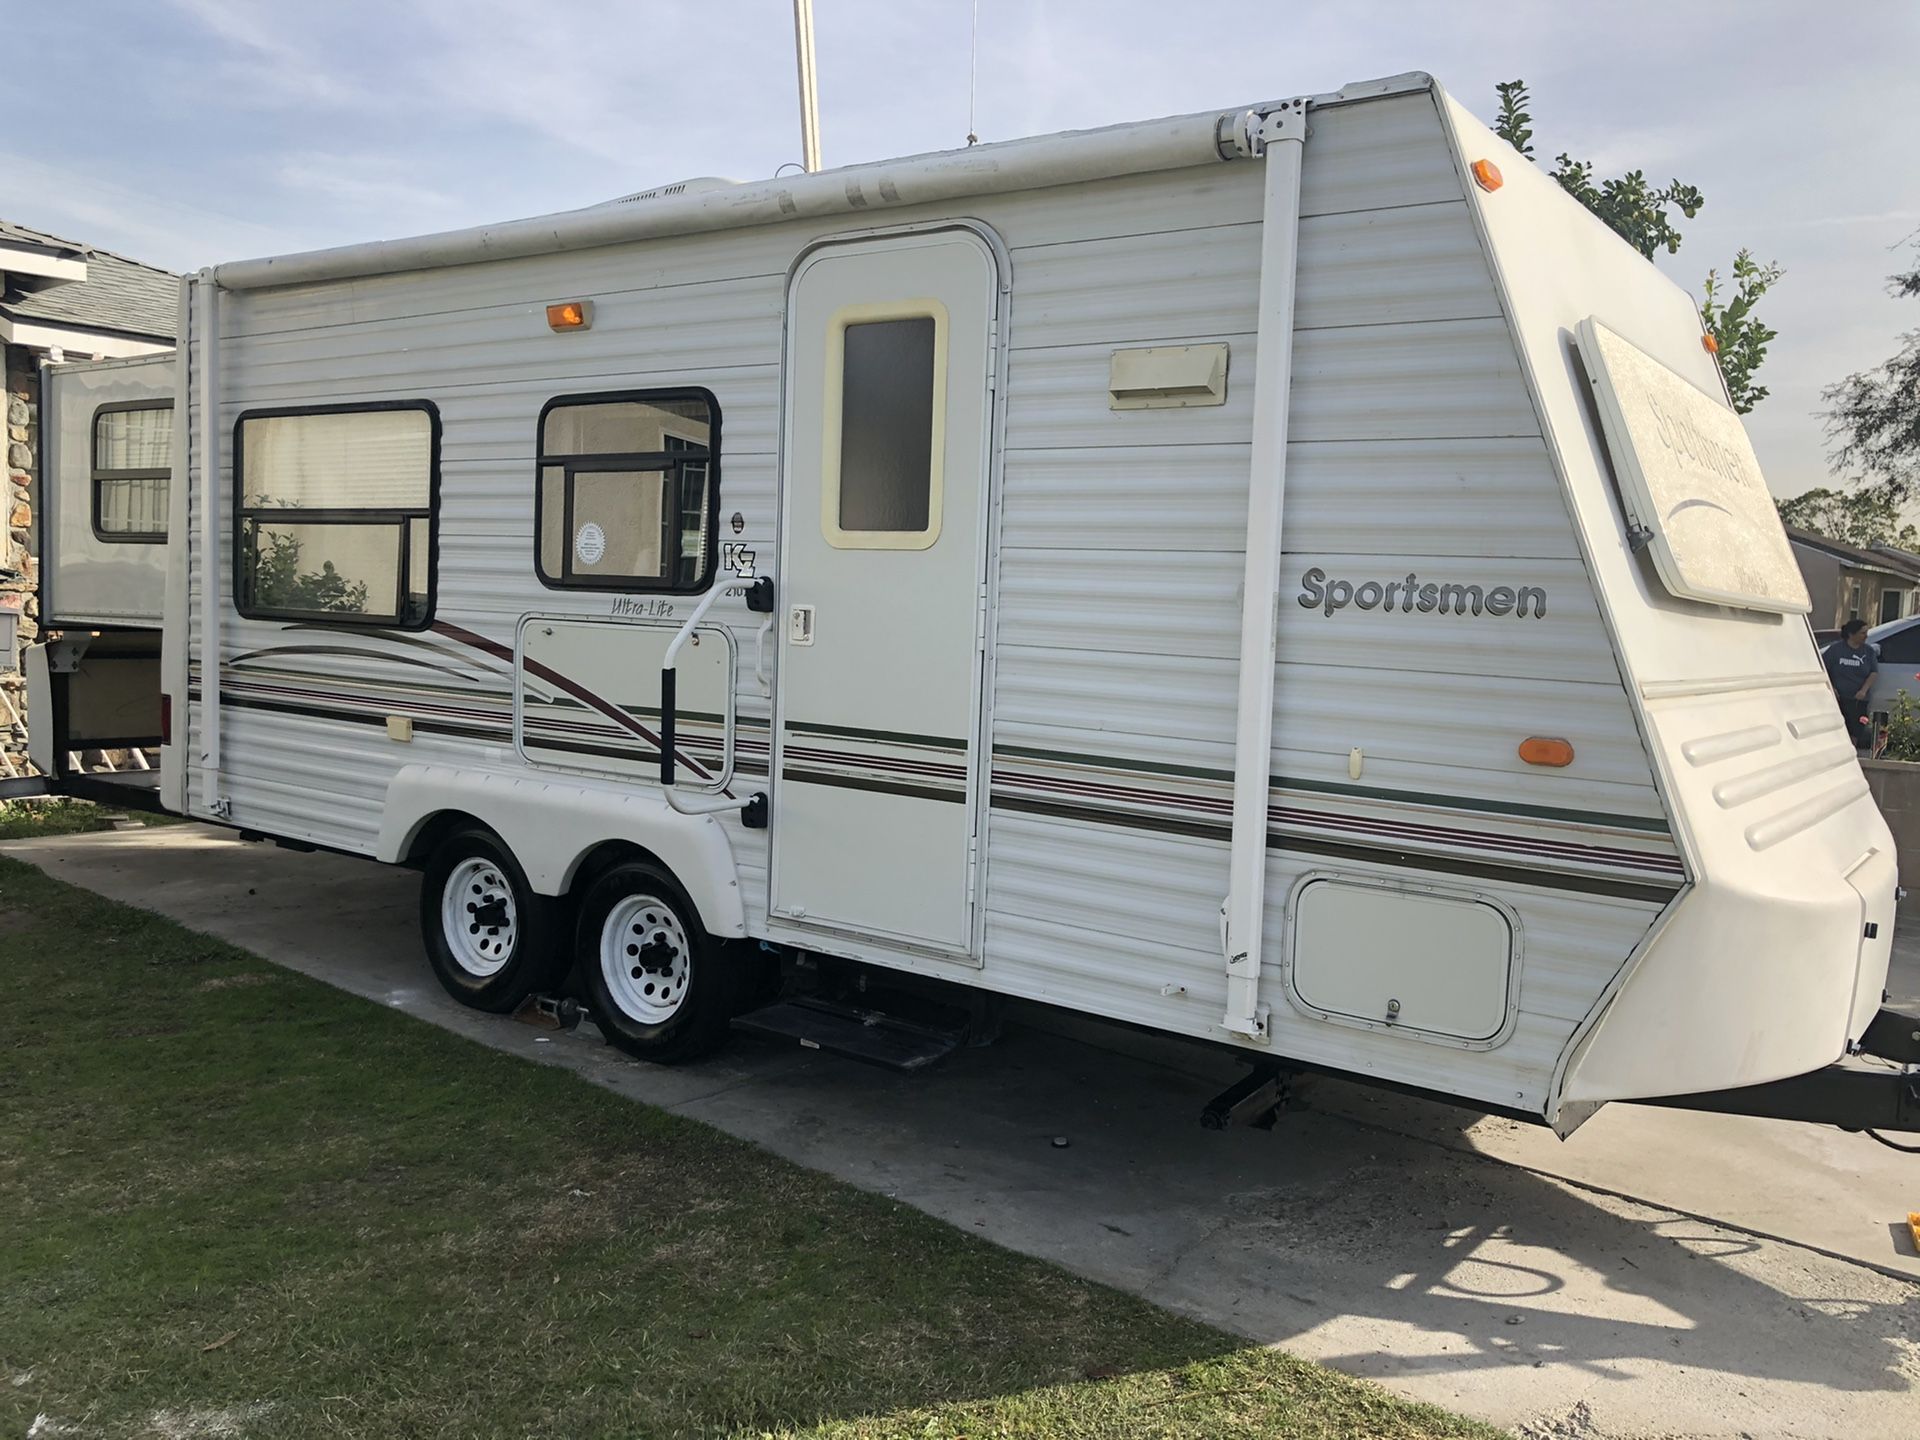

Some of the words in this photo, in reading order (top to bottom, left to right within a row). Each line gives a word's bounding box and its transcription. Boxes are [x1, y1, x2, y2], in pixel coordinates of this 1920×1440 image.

[1297, 567, 1547, 619] Sportsmen
[611, 598, 674, 617] Ultra-Lite
[1839, 657, 1861, 667] PUMA
